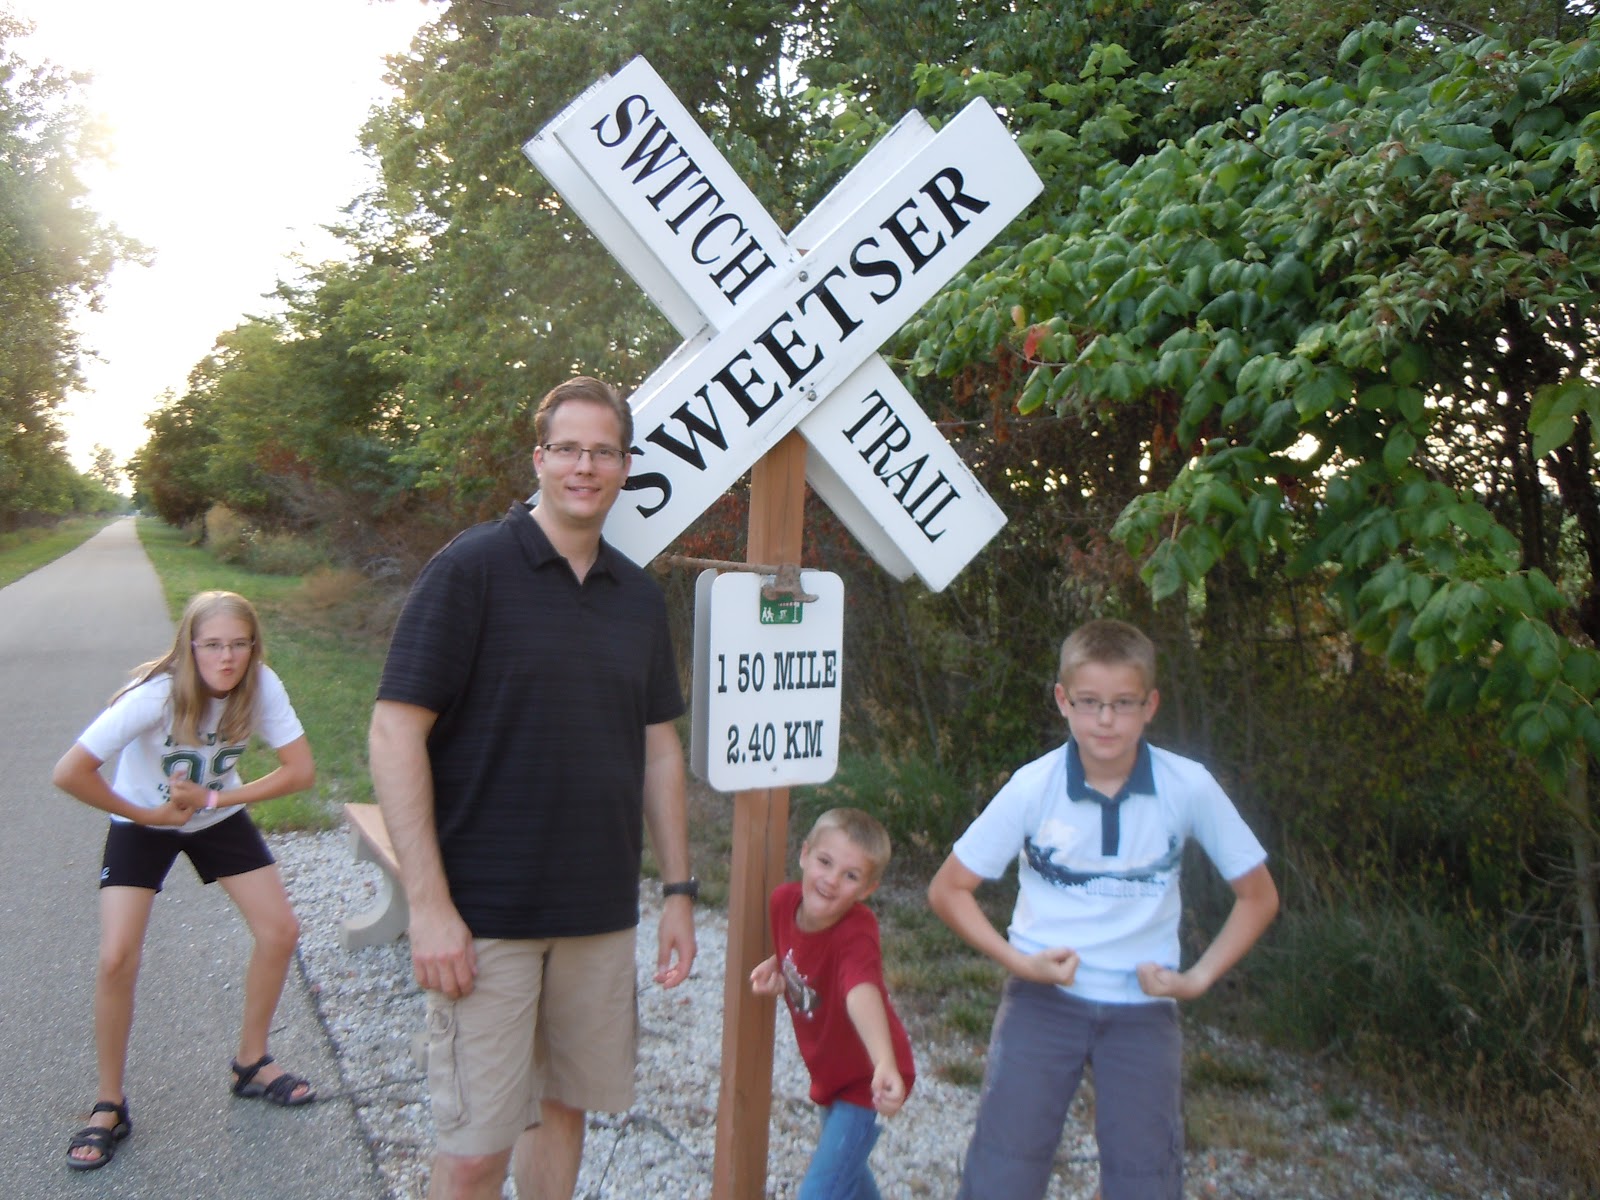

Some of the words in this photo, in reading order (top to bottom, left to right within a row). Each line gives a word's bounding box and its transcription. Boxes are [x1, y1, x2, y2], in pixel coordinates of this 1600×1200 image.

[590, 94, 777, 306] SWITCH
[843, 390, 962, 543] TRAIL
[622, 167, 990, 518] SWEETSER
[727, 723, 775, 763] 2.40
[784, 720, 823, 759] KM
[774, 651, 836, 690] MILE
